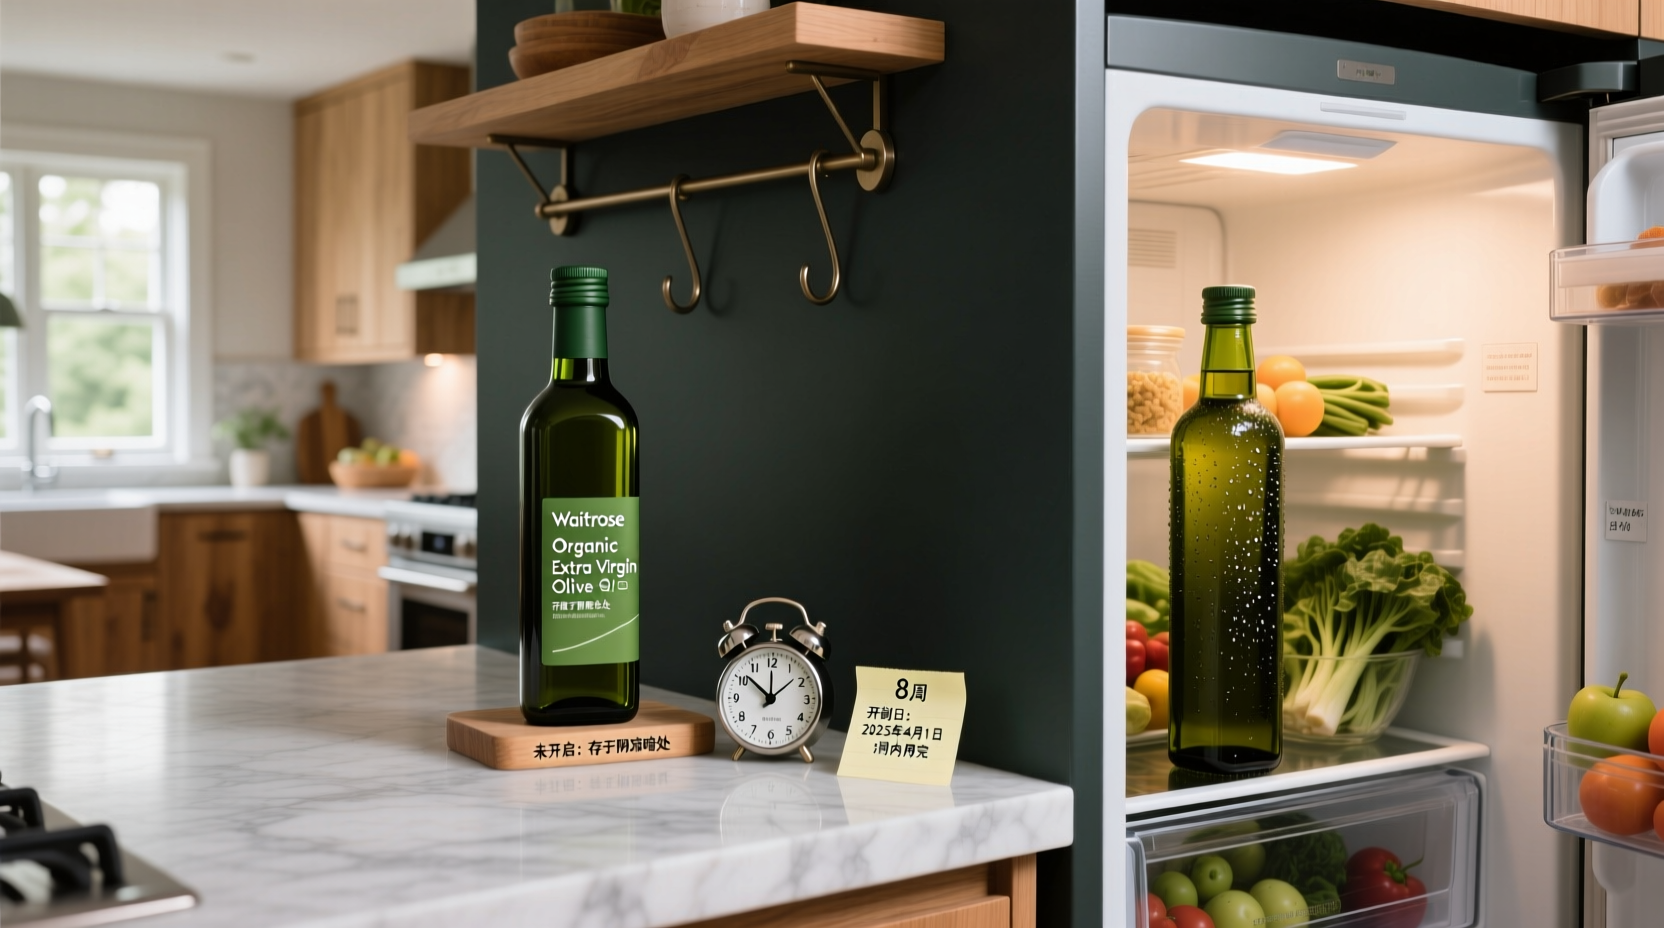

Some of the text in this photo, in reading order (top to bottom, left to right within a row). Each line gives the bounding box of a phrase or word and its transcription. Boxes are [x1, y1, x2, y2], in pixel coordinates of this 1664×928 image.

[551, 511, 625, 527] Waitrose
[552, 536, 619, 558] Organic
[552, 557, 637, 578] Extra Virgin
[551, 577, 594, 594] Olive
[751, 662, 759, 673] 11
[767, 657, 778, 669] 12
[738, 675, 749, 686] 10
[797, 677, 805, 688] 2
[895, 677, 928, 703] 8周
[733, 692, 740, 703] 9
[803, 694, 811, 705] 3
[738, 711, 746, 722] 8
[797, 712, 804, 722] 4
[750, 724, 757, 736] 7
[767, 729, 775, 740] 6
[785, 725, 793, 736] 5
[861, 723, 943, 741] 2025年4月1日
